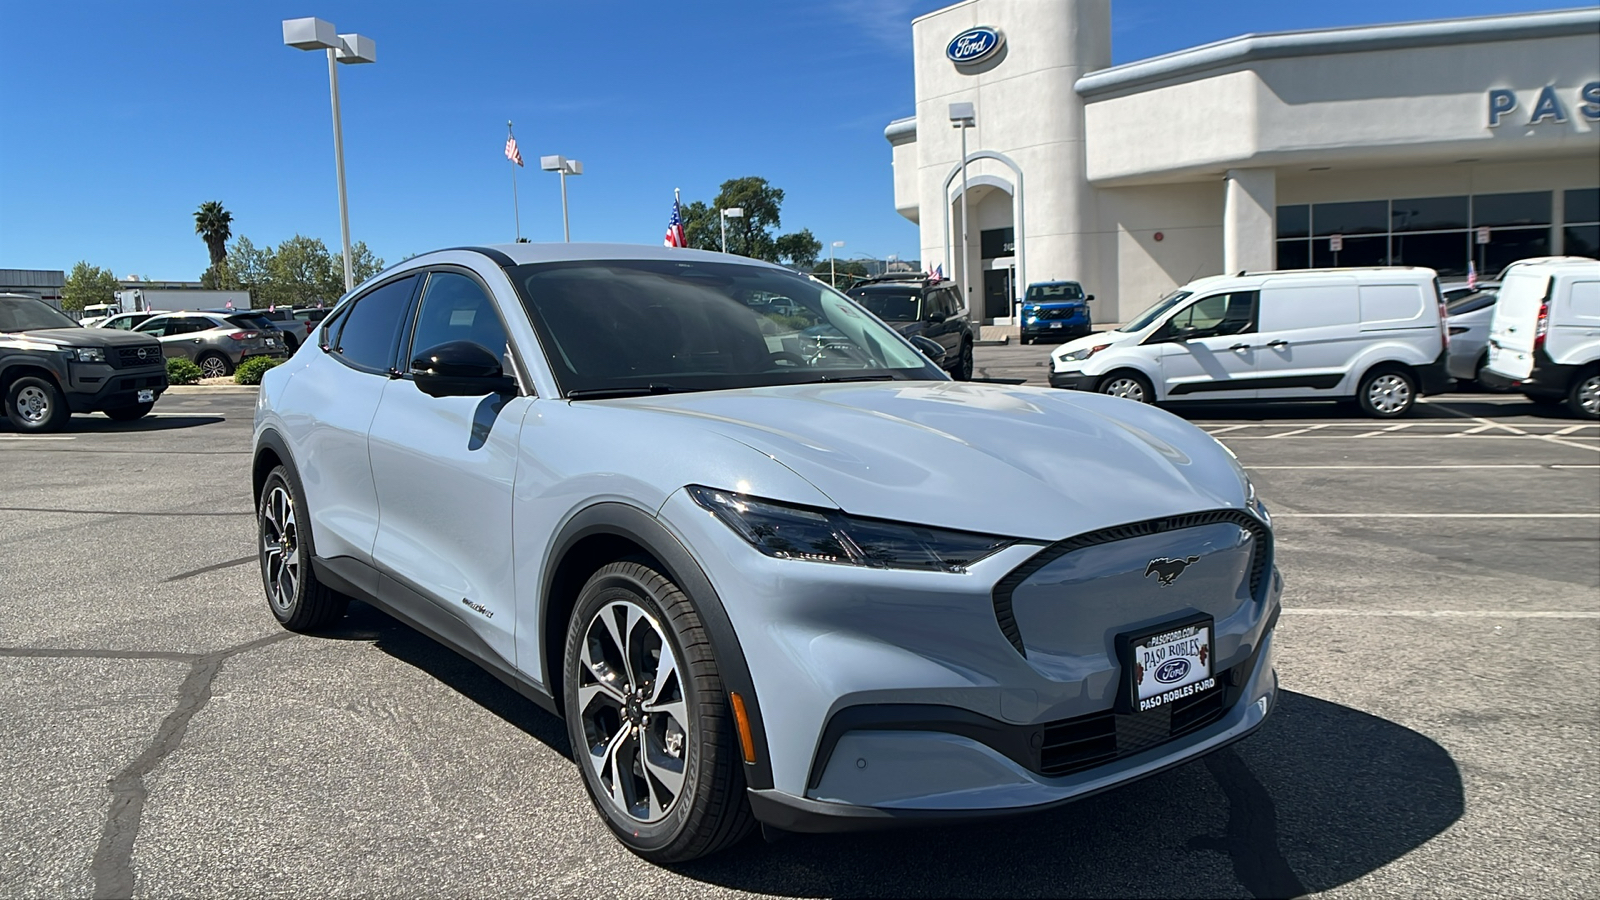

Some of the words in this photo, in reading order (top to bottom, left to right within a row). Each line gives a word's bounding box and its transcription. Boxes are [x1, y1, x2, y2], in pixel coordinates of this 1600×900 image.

[954, 33, 987, 57] Ford
[1488, 82, 1600, 125] PAS
[1144, 647, 1165, 671] PASO
[1169, 638, 1199, 656] ROBLES
[1162, 662, 1185, 680] Ford
[1140, 696, 1162, 711] PASO
[1163, 685, 1194, 703] ROBLES
